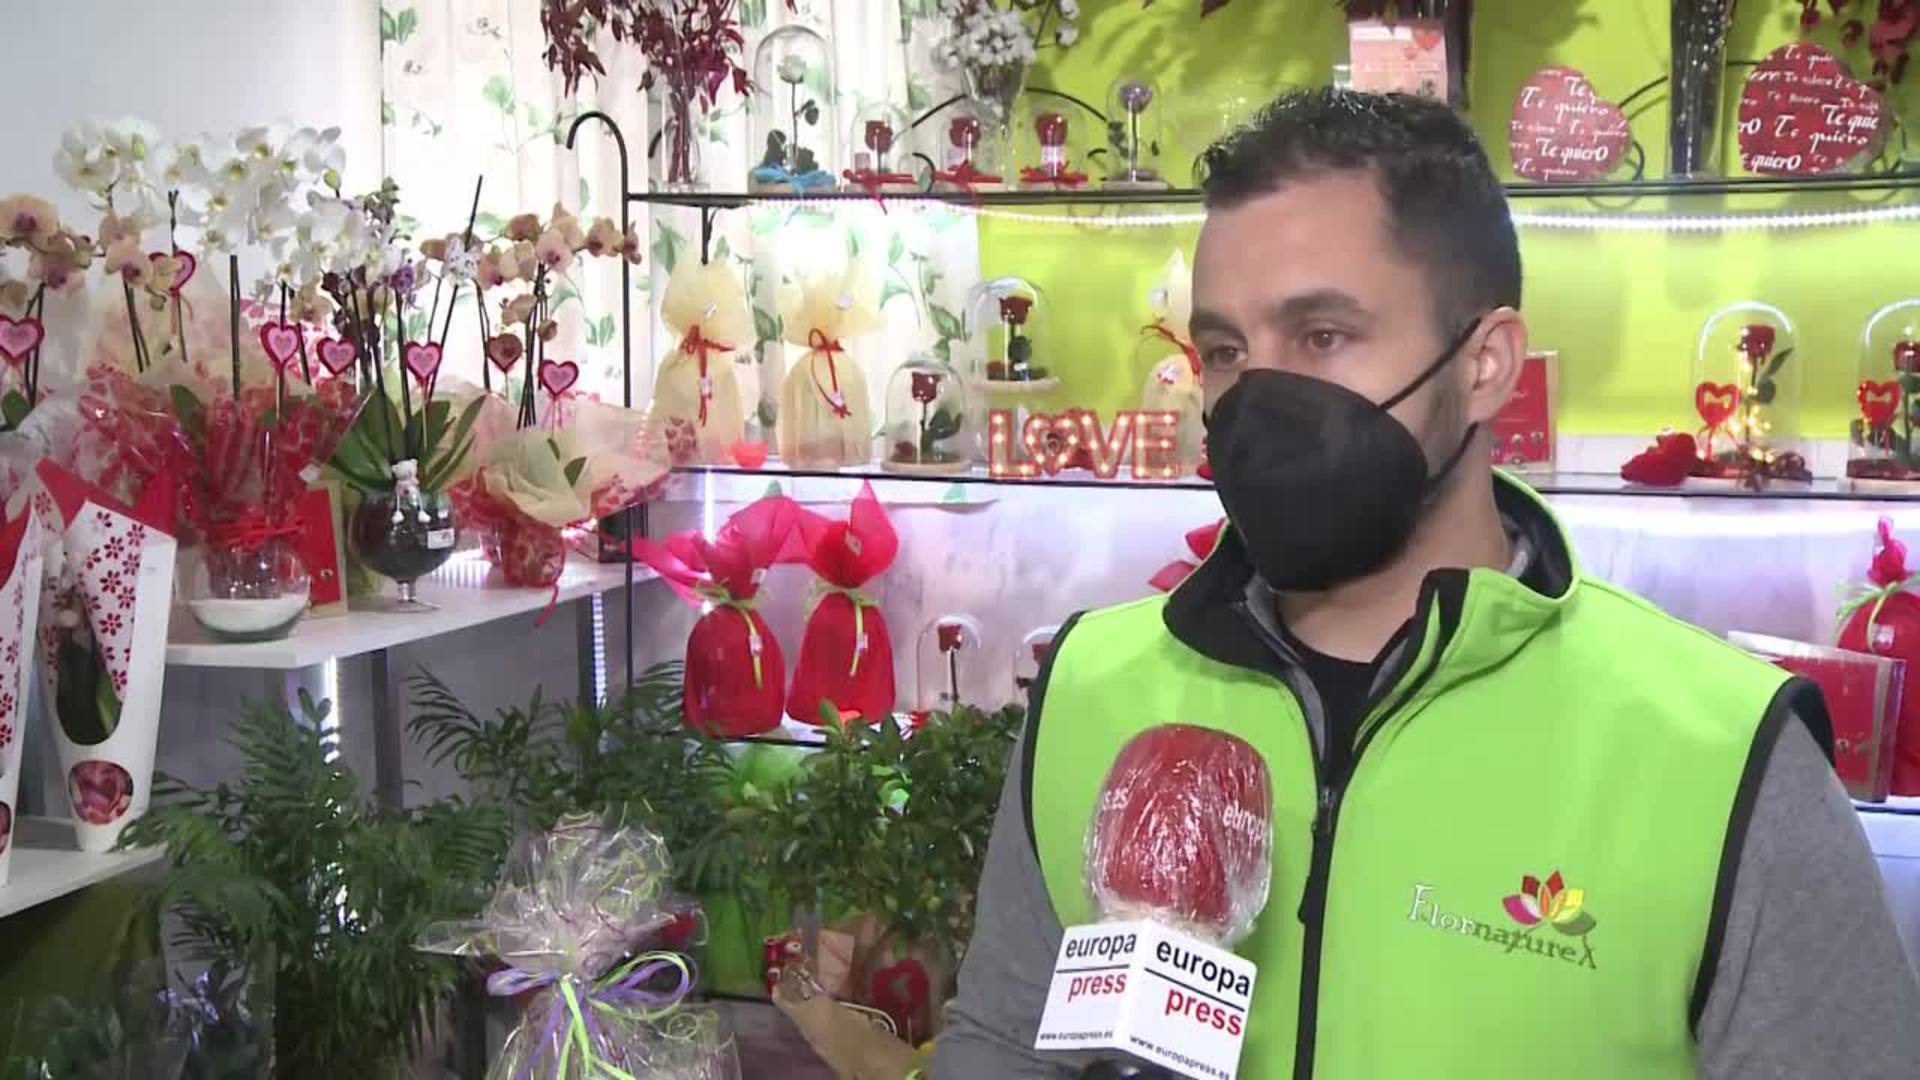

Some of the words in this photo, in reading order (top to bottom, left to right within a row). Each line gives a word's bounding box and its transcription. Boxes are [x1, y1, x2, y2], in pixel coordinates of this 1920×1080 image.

[1521, 86, 1546, 109] Te
[1554, 102, 1609, 124] quiero
[1563, 75, 1587, 97] Te
[1821, 104, 1846, 126] Te
[1536, 137, 1558, 158] Te
[1774, 114, 1799, 138] Te
[1808, 130, 1869, 155] quiero
[989, 408, 1181, 480] LOVE
[1065, 933, 1137, 961] europa
[1156, 940, 1251, 997] europa
[1067, 973, 1127, 1003] press
[1165, 988, 1242, 1037] press
[1129, 1034, 1231, 1080] www.europapress.es
